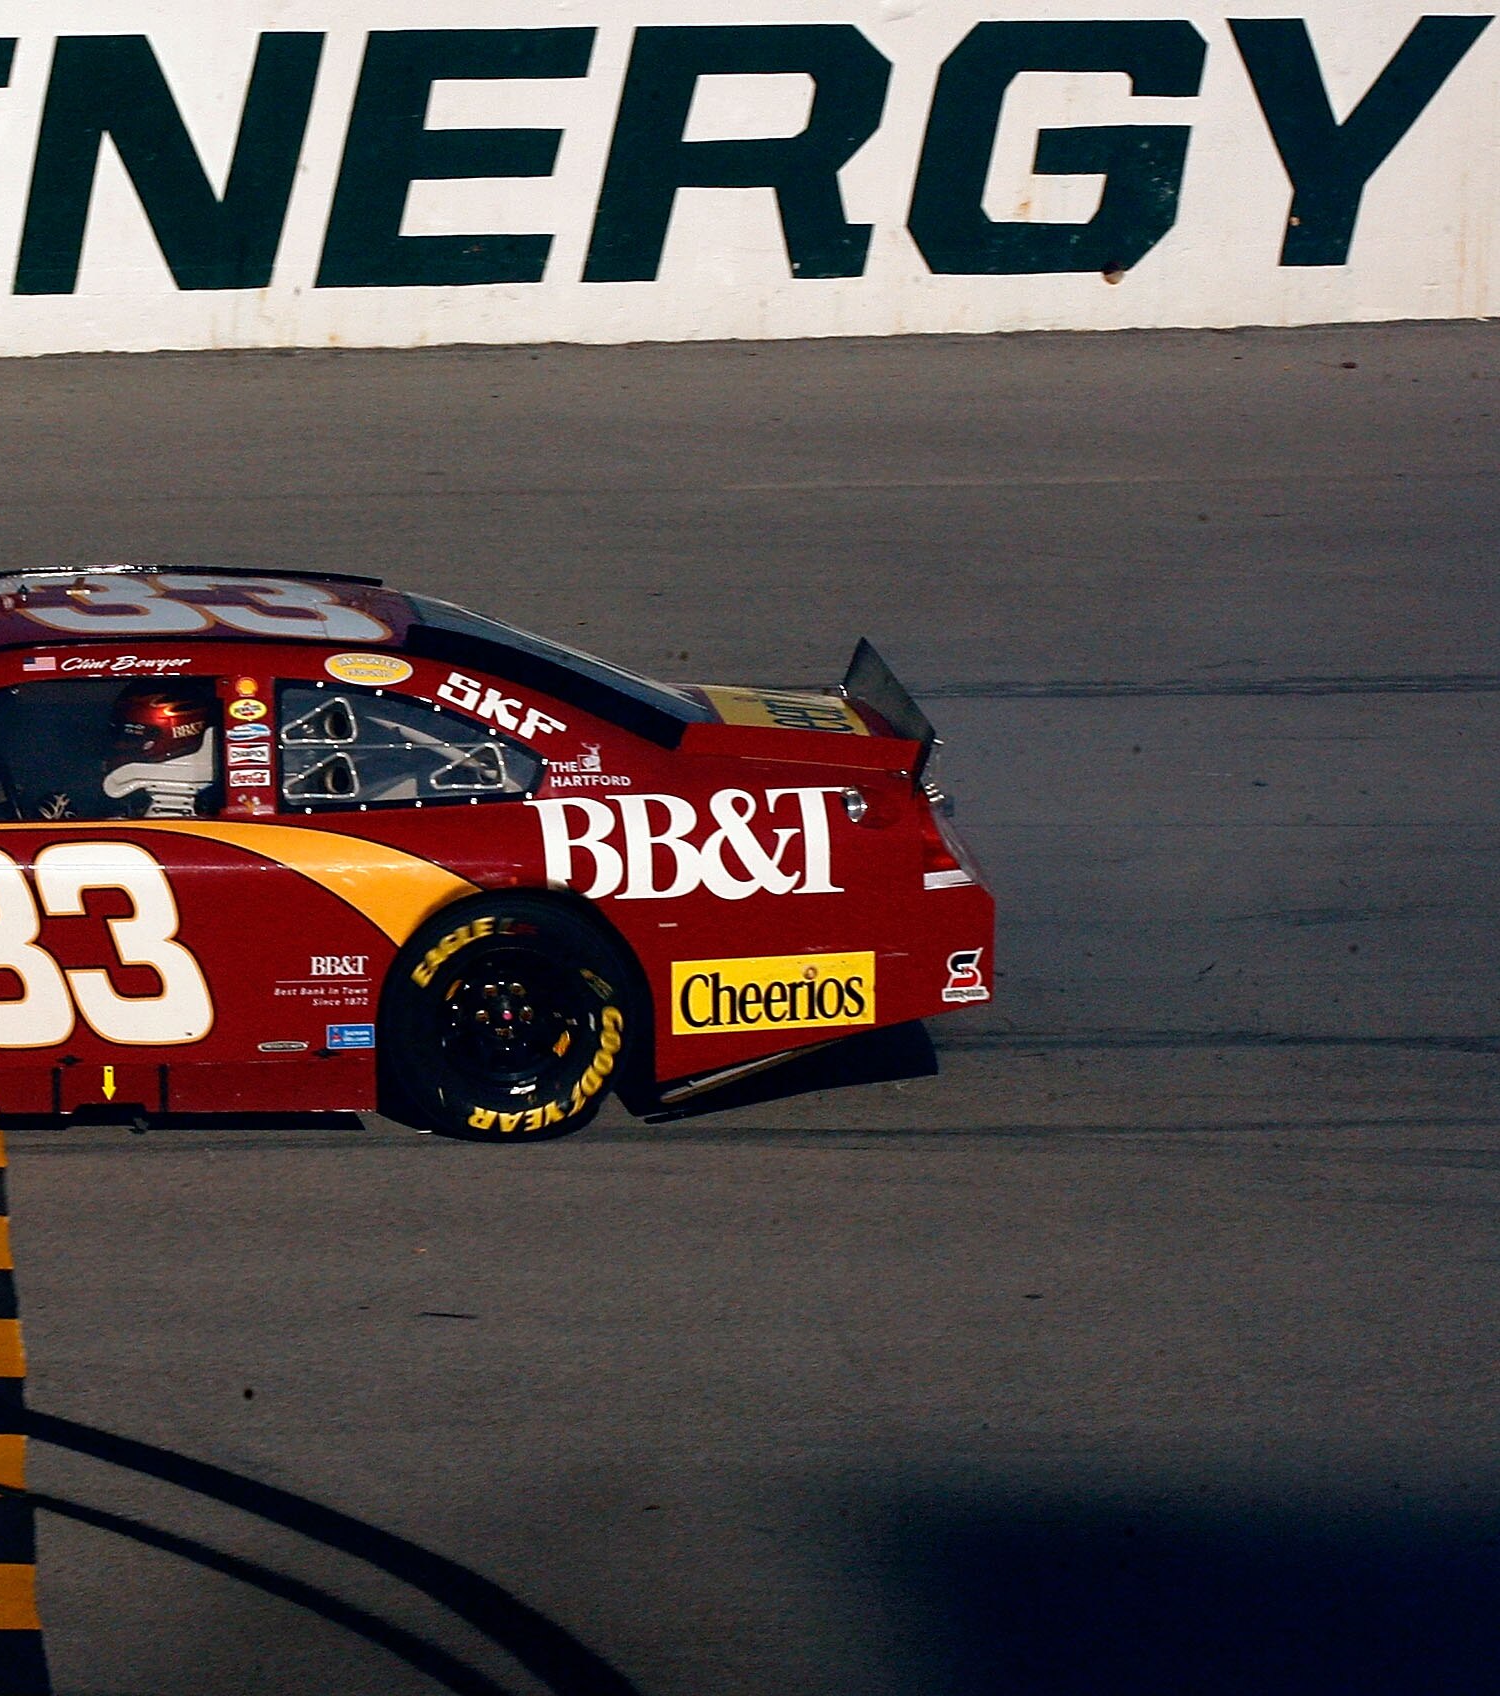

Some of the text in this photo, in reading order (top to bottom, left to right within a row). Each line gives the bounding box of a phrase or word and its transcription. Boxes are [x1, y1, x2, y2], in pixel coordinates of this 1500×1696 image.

[61, 655, 192, 671] Clint Bowyer
[436, 671, 568, 740] SKF
[551, 761, 578, 773] THE
[550, 775, 632, 787] HARTFORD
[523, 786, 849, 901] BB&T
[309, 955, 370, 976] BB&T
[300, 987, 325, 996] Bank
[679, 972, 865, 1030] Cheerios
